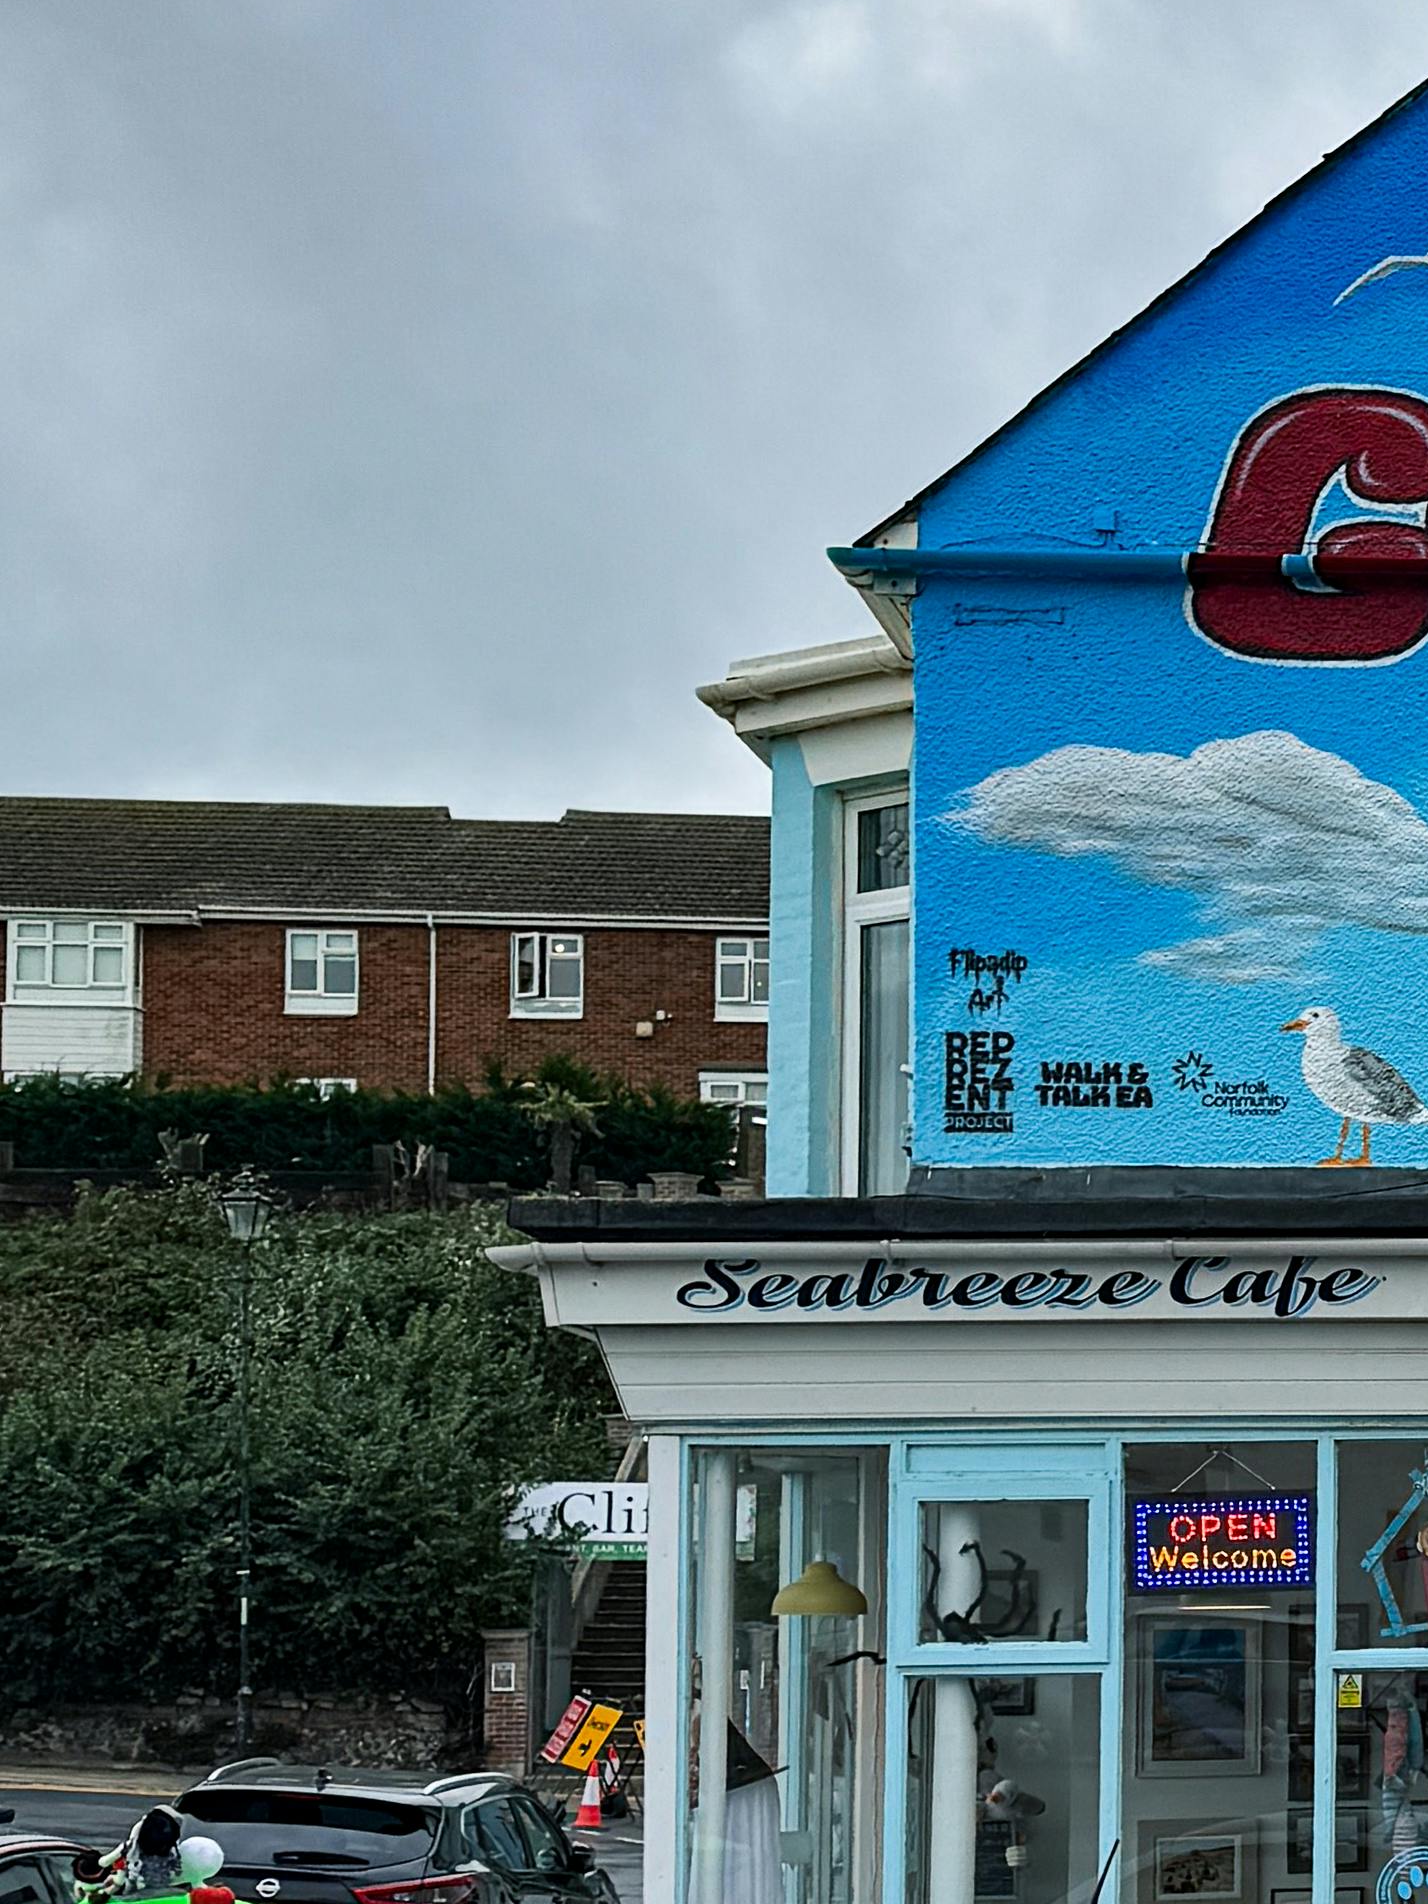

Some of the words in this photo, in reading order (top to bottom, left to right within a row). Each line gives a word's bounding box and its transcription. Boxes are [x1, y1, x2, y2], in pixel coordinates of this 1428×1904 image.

[1040, 1062, 1122, 1084] WALK
[1127, 1063, 1149, 1084] &
[1034, 1085, 1110, 1107] TALK
[1116, 1085, 1153, 1108] EA
[1214, 1080, 1269, 1094] Norfolk
[1202, 1093, 1289, 1109] Community
[945, 1113, 1013, 1131] PROJECT
[676, 1258, 1163, 1313] Seabreeze
[1169, 1255, 1381, 1319] Cafe
[557, 1490, 648, 1534] Cli
[1169, 1513, 1277, 1543] OPEN
[1149, 1544, 1298, 1573] Welcome
